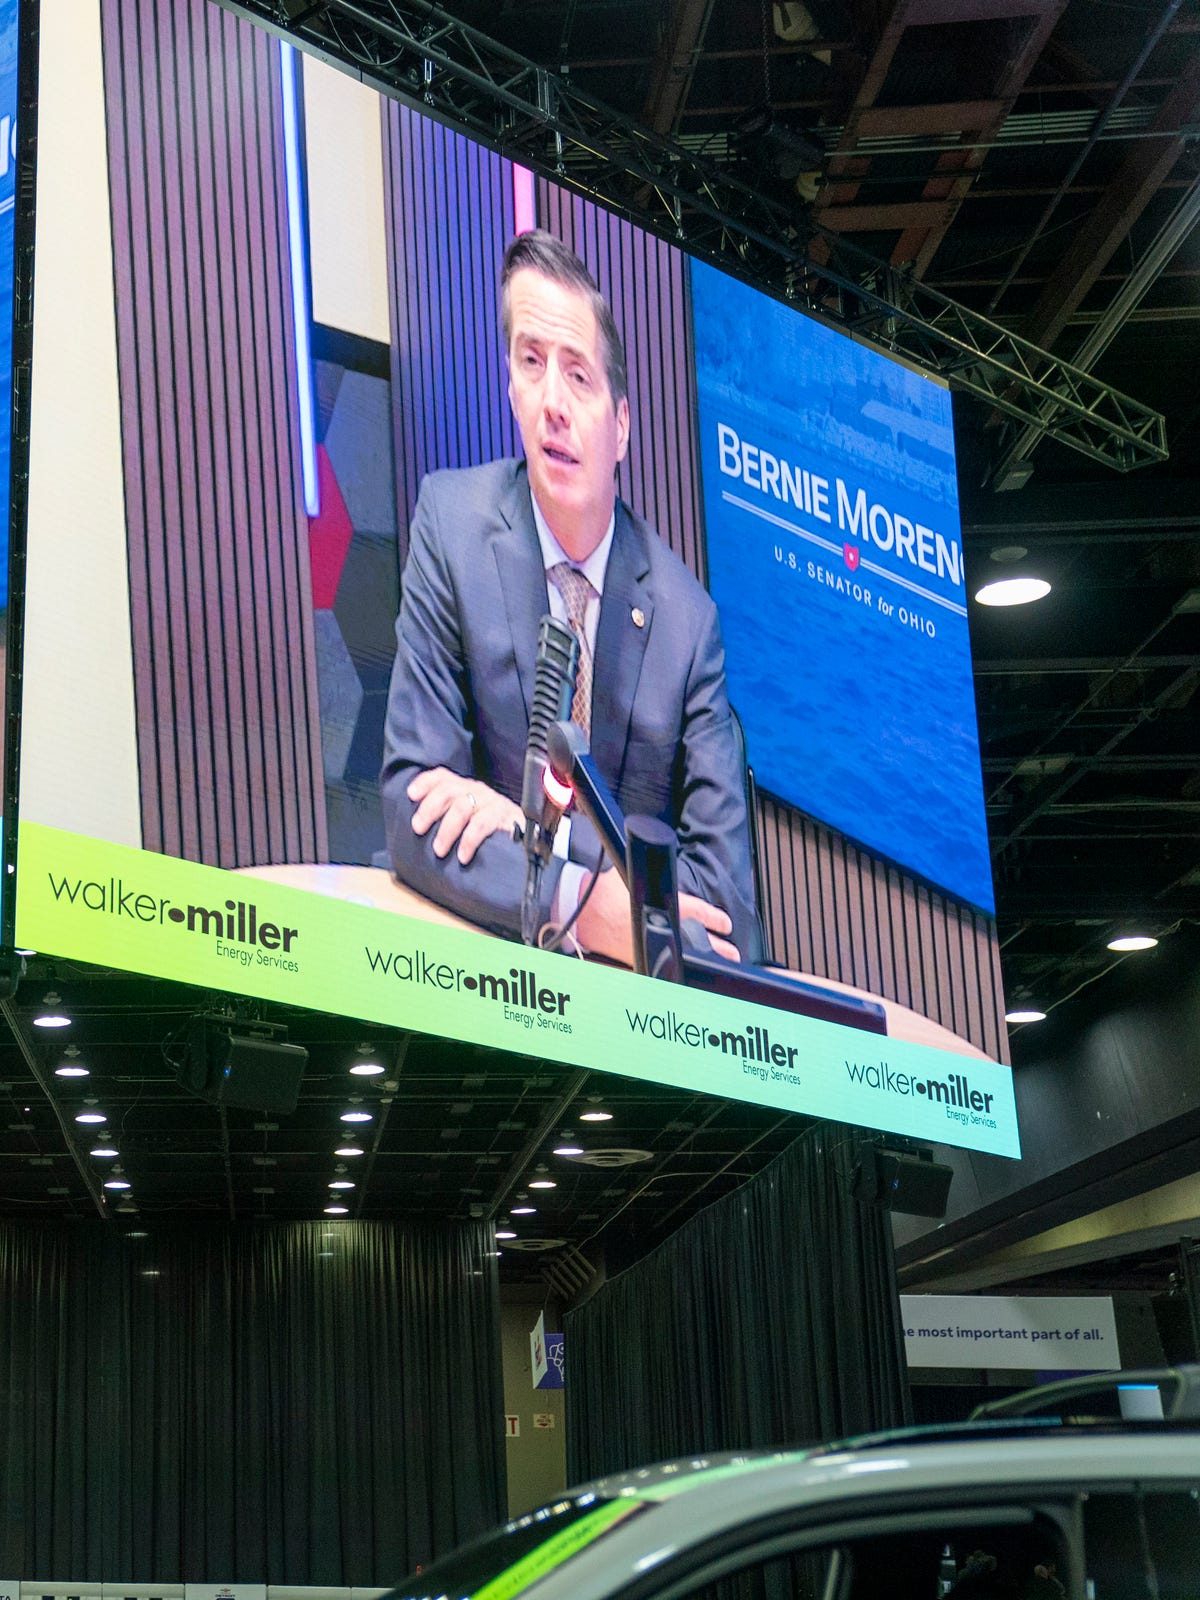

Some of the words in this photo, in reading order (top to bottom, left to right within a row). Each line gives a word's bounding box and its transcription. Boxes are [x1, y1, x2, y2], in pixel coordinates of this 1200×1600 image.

[717, 422, 832, 523] BERNIE
[835, 477, 965, 586] MOREN
[774, 545, 801, 573] U.S.
[807, 560, 872, 607] SENATOR
[878, 596, 894, 617] for
[898, 607, 936, 638] OHIO
[215, 940, 254, 968] Energy
[255, 948, 299, 973] Services
[503, 1005, 535, 1030] Energy
[536, 1012, 573, 1034] Services
[742, 1060, 770, 1082] Energy
[771, 1066, 801, 1086] Services
[946, 1106, 970, 1126] Energy
[970, 1111, 997, 1130] Services
[918, 1327, 953, 1338] most
[956, 1326, 1028, 1341] important
[1031, 1329, 1062, 1342] part
[1064, 1328, 1081, 1340] of
[1083, 1328, 1104, 1340] all.
